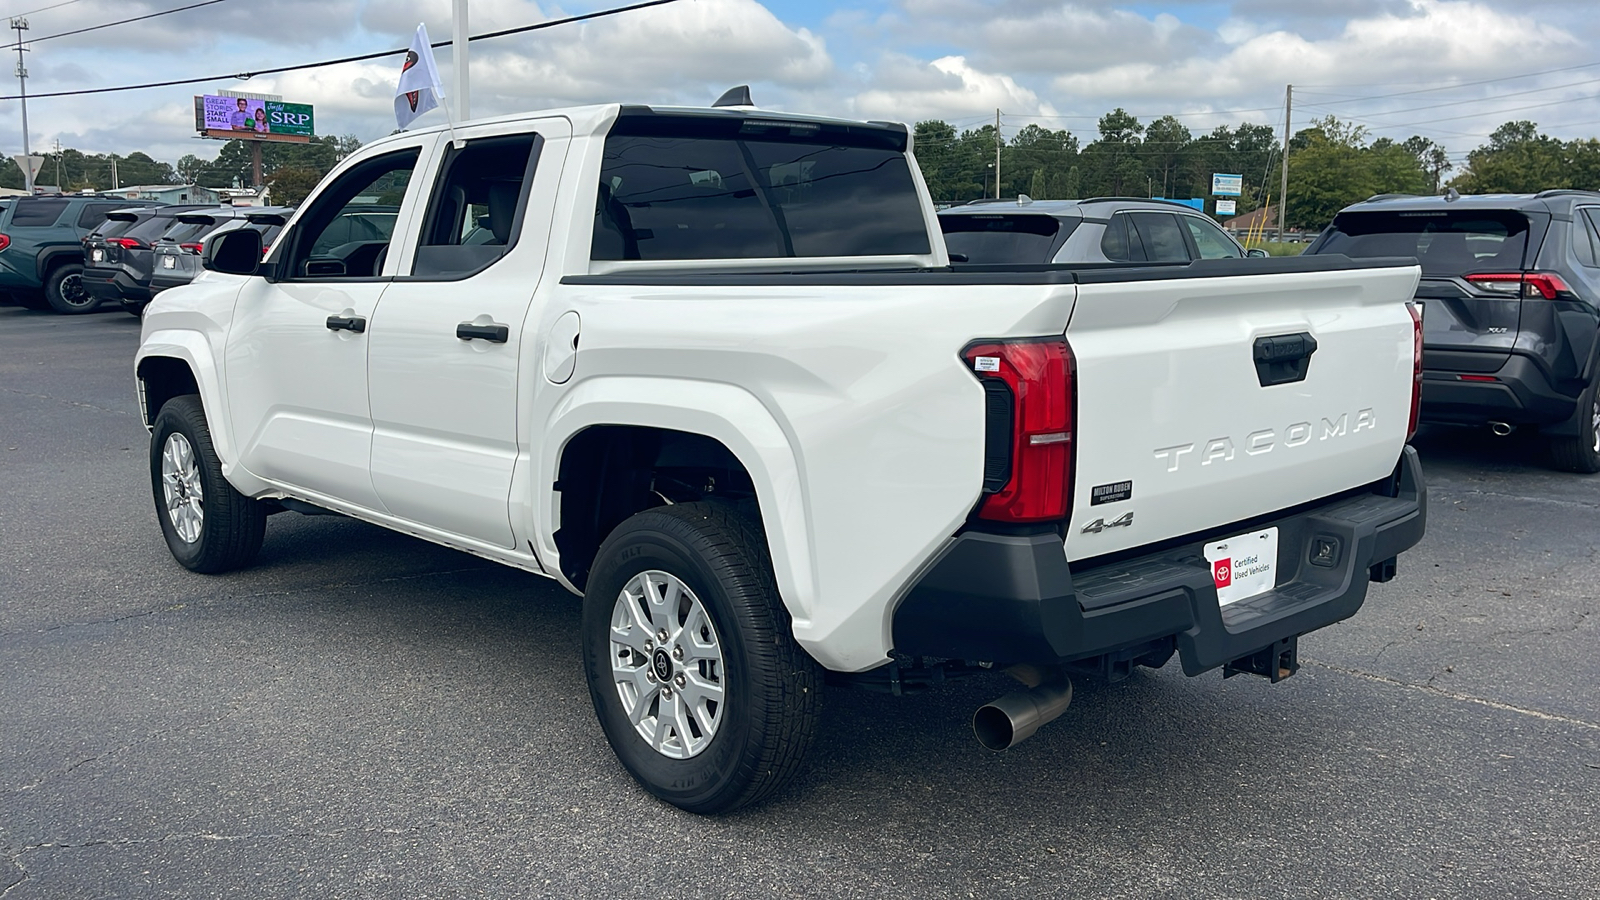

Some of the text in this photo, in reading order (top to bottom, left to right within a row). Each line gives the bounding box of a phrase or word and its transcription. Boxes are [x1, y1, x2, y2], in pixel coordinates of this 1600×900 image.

[205, 97, 228, 105] GREAT
[206, 104, 233, 112] STORIES
[270, 111, 310, 125] SRP
[1153, 407, 1376, 473] TACOMA
[1093, 485, 1113, 497] MILTON
[1234, 554, 1258, 568] Certified
[1234, 563, 1270, 580] Used Vehicles
